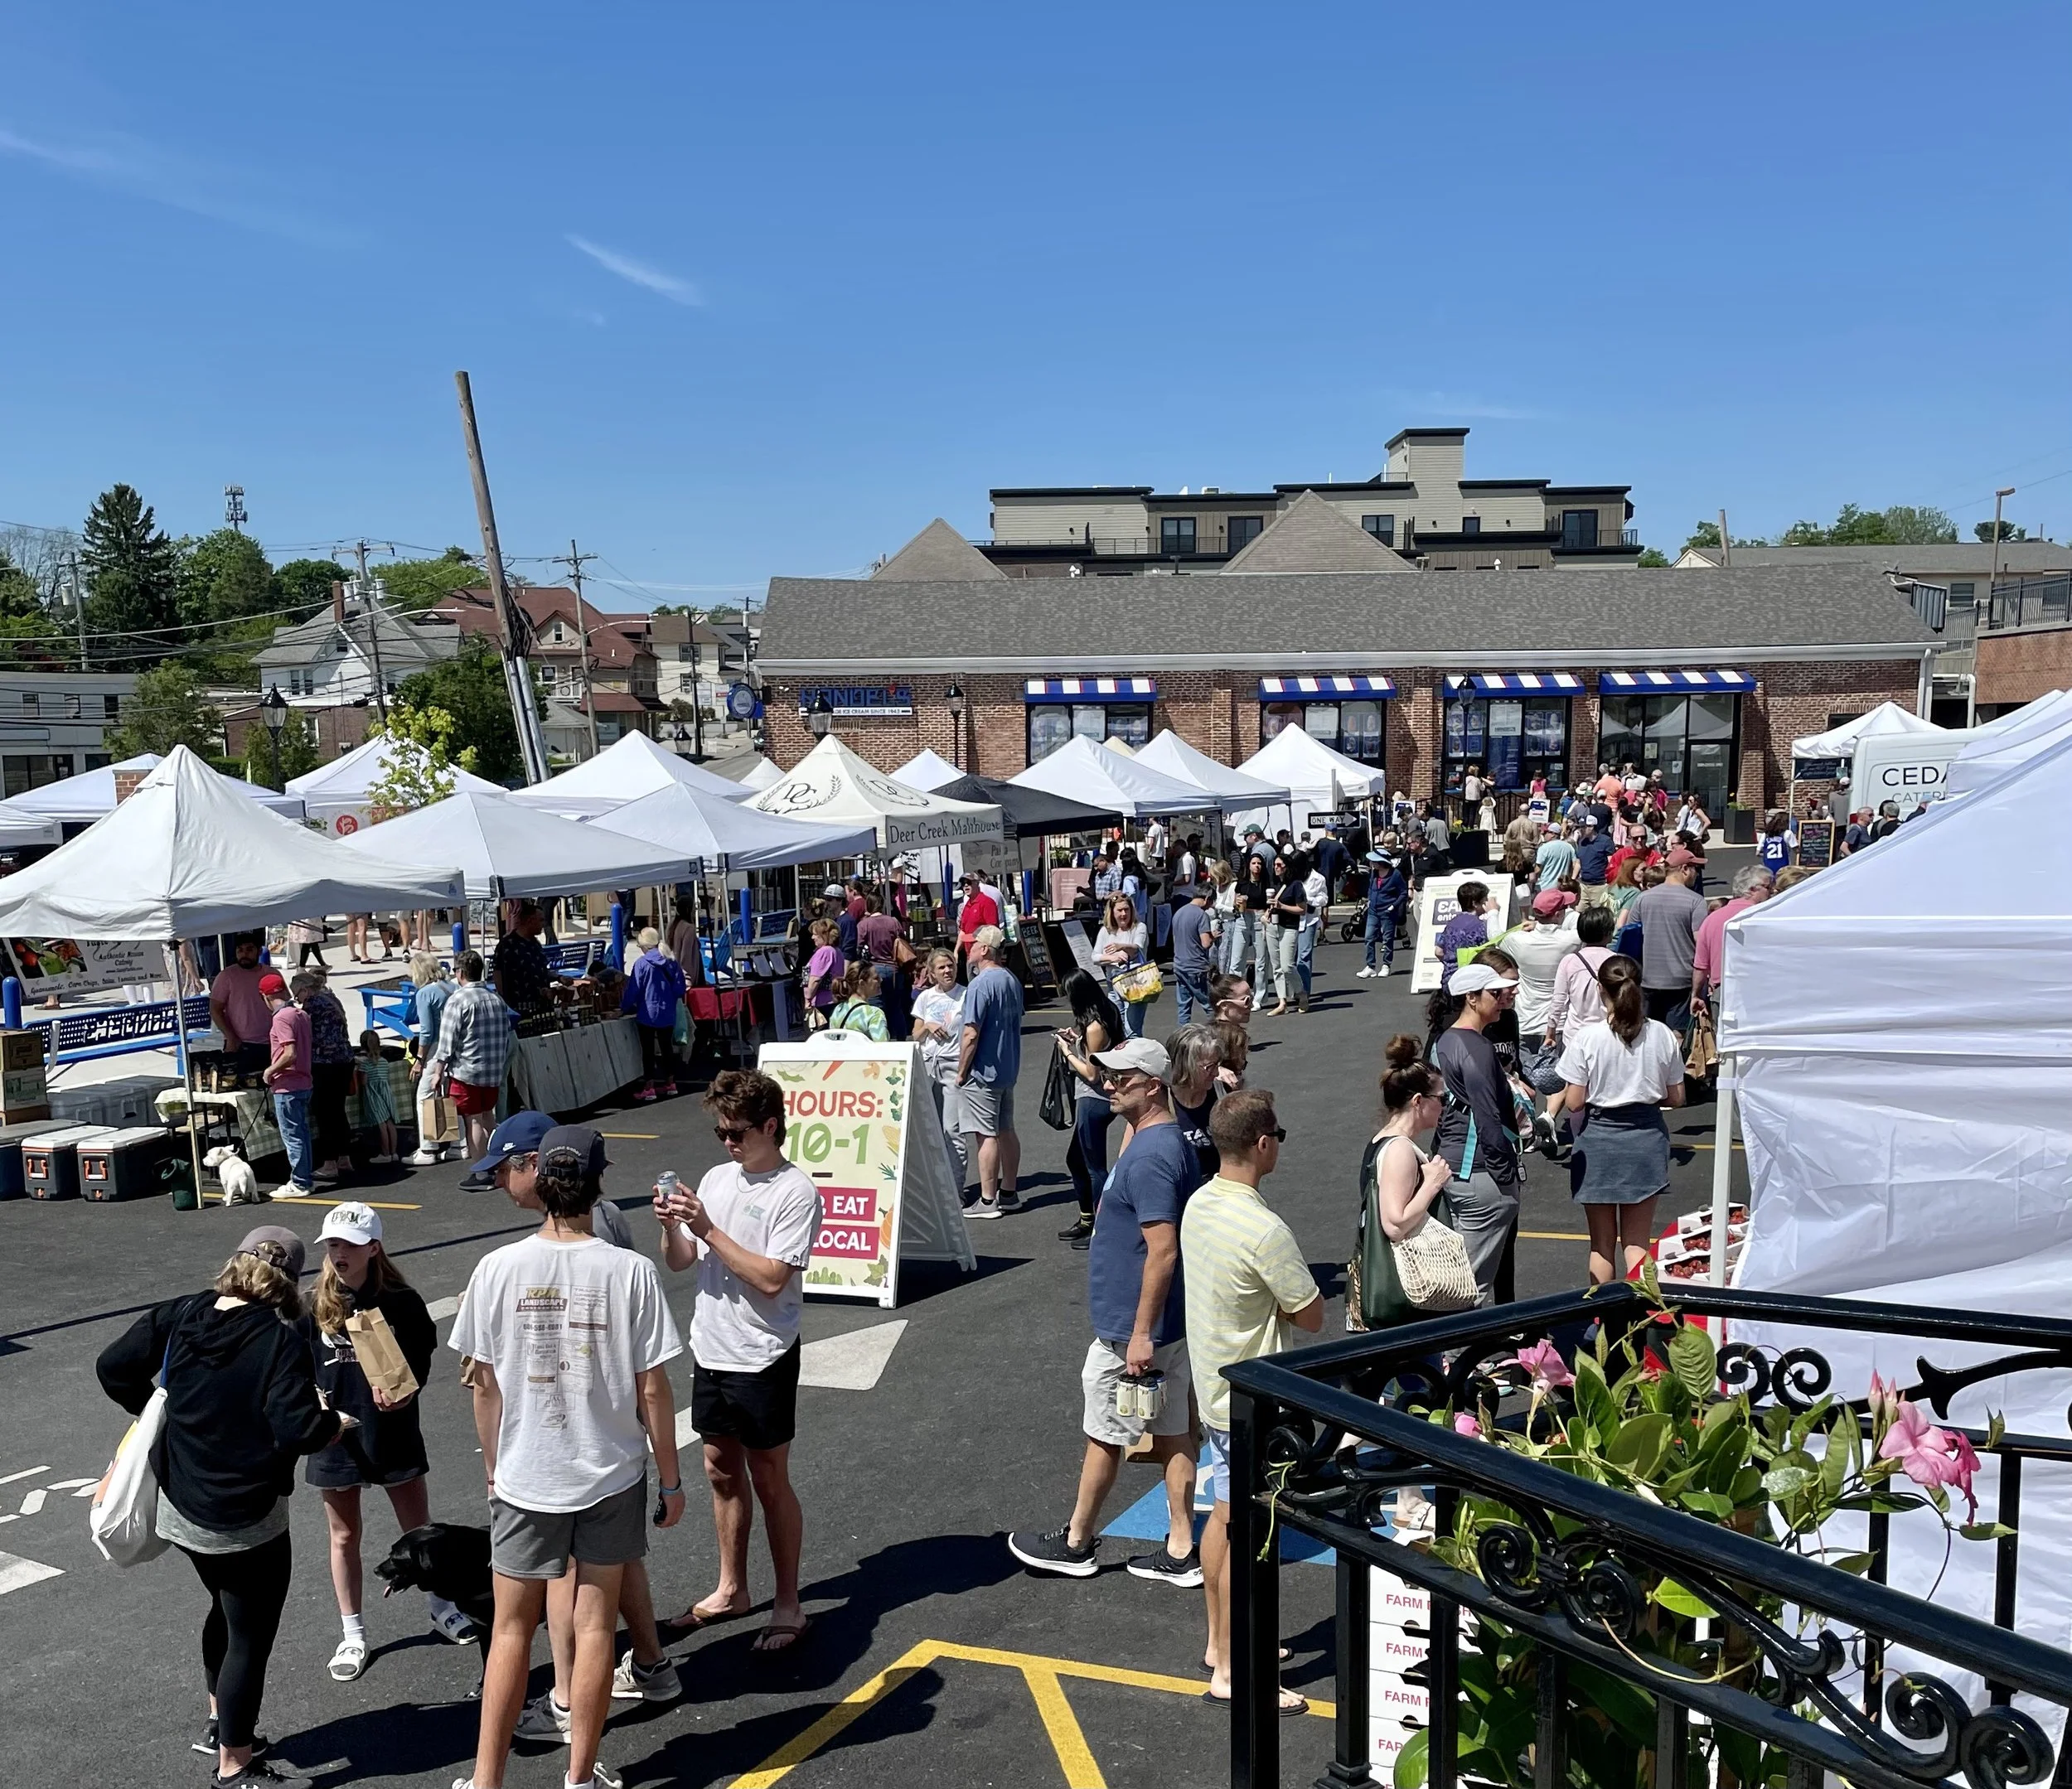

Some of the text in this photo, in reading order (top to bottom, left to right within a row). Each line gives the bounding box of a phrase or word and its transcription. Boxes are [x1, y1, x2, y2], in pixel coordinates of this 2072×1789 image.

[890, 817, 1000, 844] Deer Creek Malthouse
[1766, 843, 1783, 858] 21
[782, 1090, 884, 1118] HOURS:
[787, 1122, 869, 1165] 10-1
[832, 1195, 869, 1216] EAT
[1386, 1594, 1423, 1610] FARM
[1386, 1642, 1423, 1658] FARM
[1384, 1690, 1421, 1706] FARM
